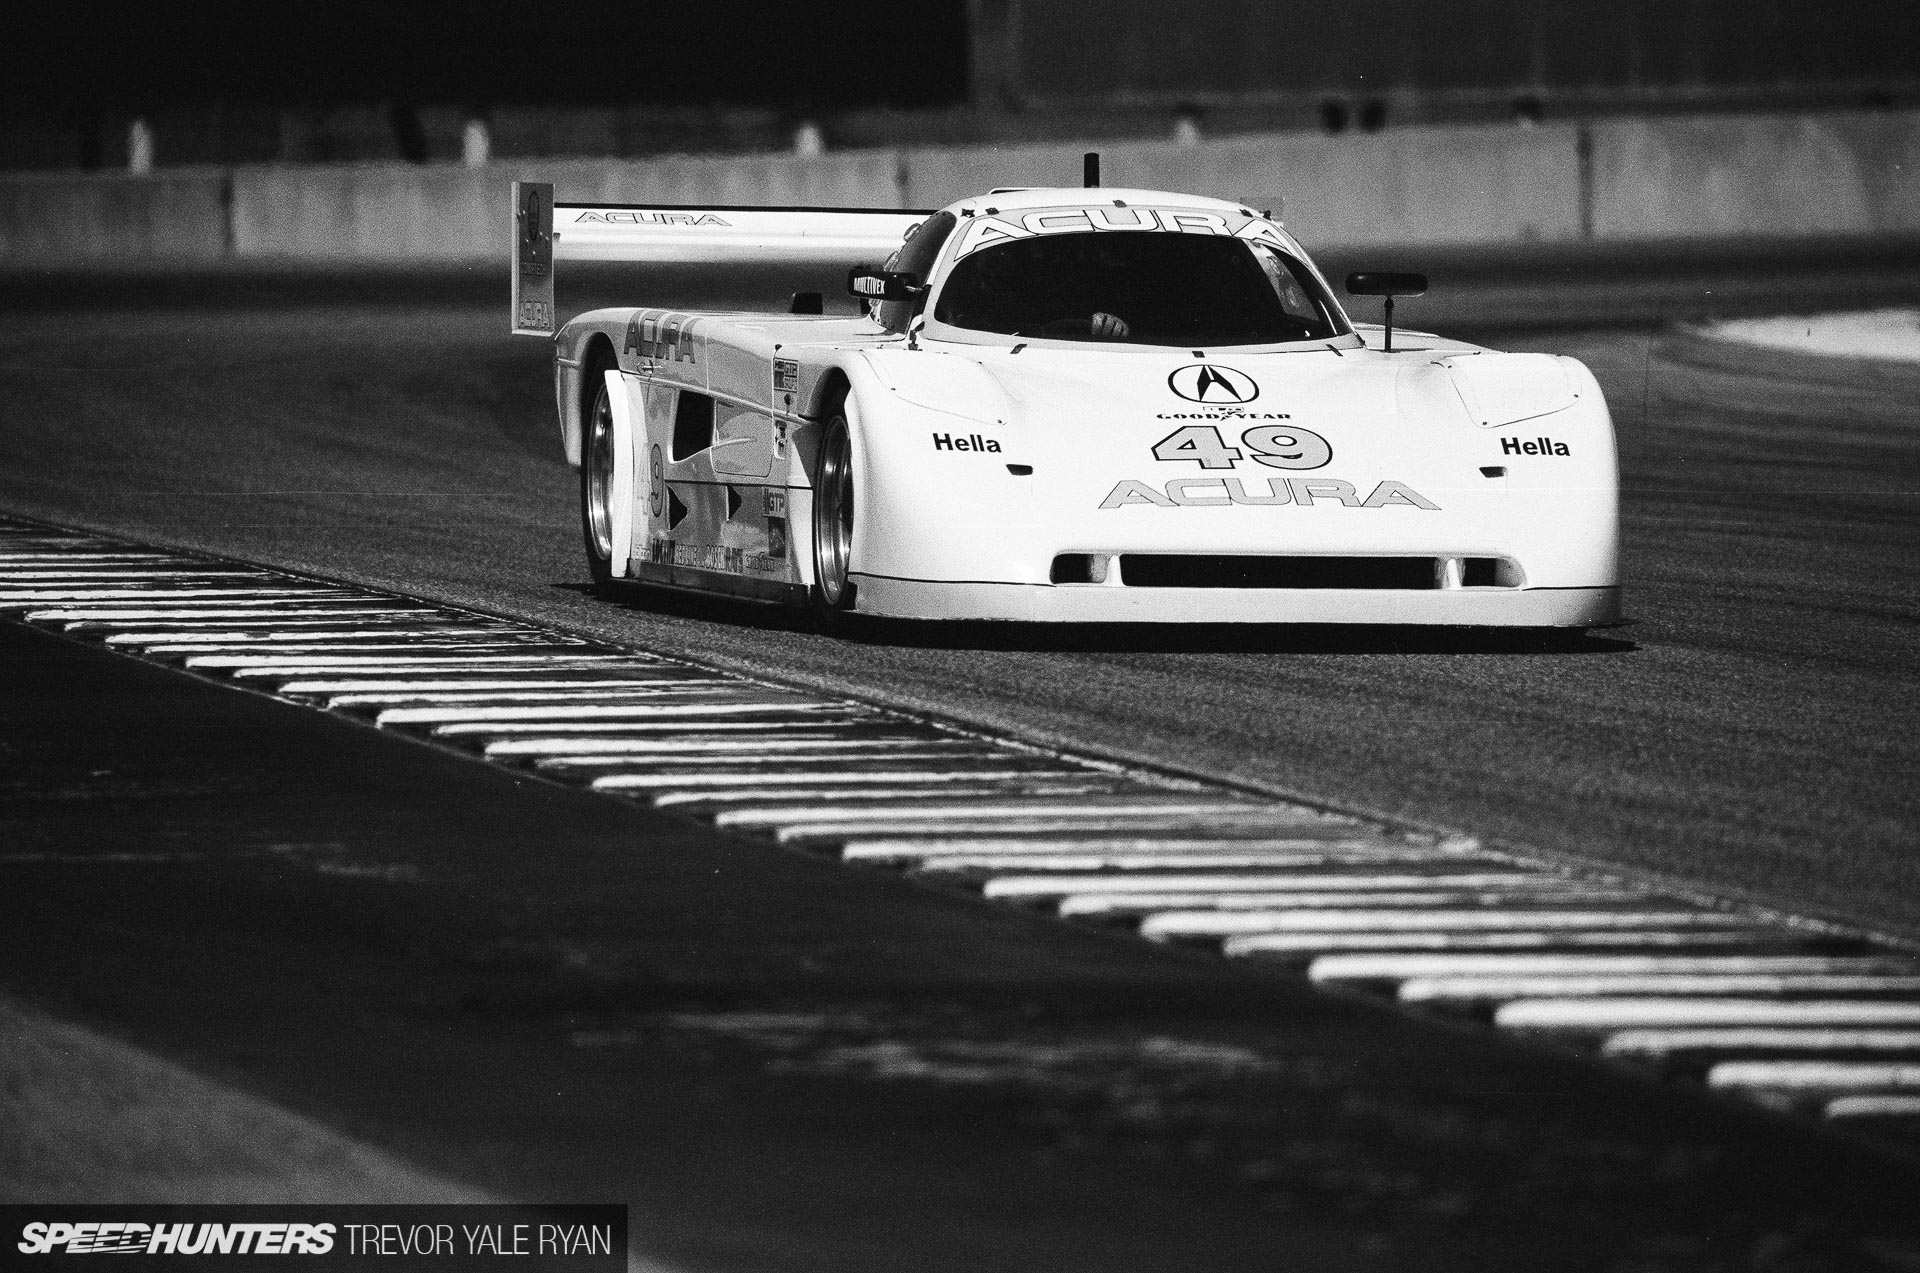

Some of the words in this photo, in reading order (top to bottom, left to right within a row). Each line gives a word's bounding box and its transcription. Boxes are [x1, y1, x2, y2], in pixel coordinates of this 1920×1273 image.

[575, 211, 732, 227] ACURA
[954, 208, 1309, 268] ACURA
[854, 276, 886, 295] MULTIVEX
[517, 301, 551, 330] ACURA
[624, 309, 696, 364] ACURA
[932, 432, 1002, 454] Hella
[1151, 425, 1333, 470] 49
[1500, 437, 1571, 457] Hella
[1098, 477, 1443, 511] ACURA
